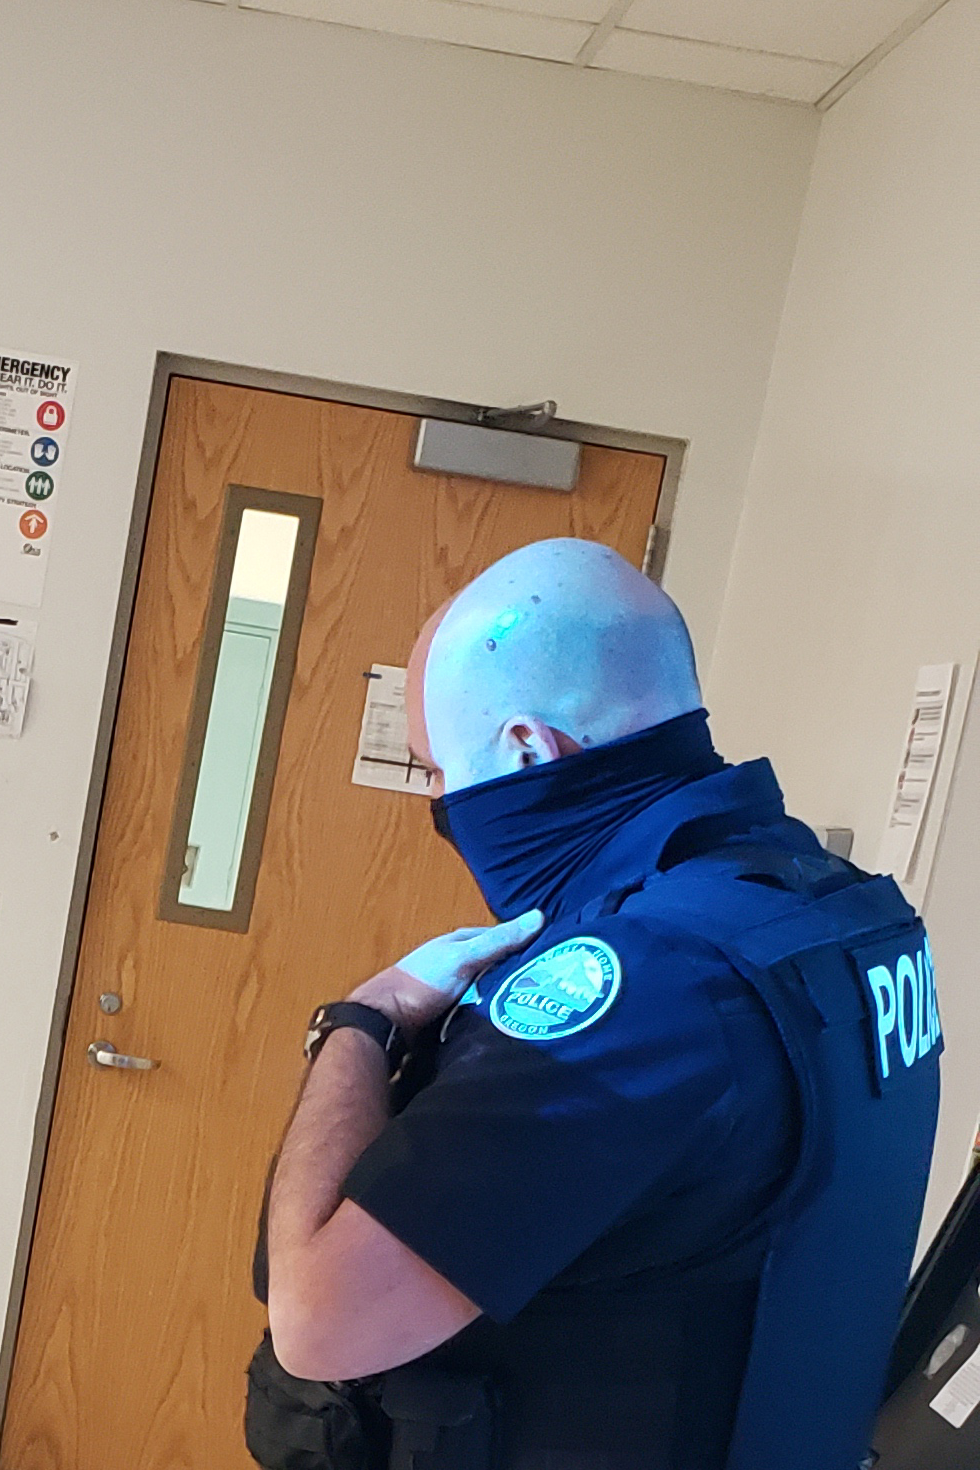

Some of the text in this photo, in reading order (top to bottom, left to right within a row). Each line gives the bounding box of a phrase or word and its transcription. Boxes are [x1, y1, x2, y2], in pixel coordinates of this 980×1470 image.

[38, 379, 54, 391] DO
[505, 991, 573, 1020] POLICE
[867, 936, 941, 1079] POLI
